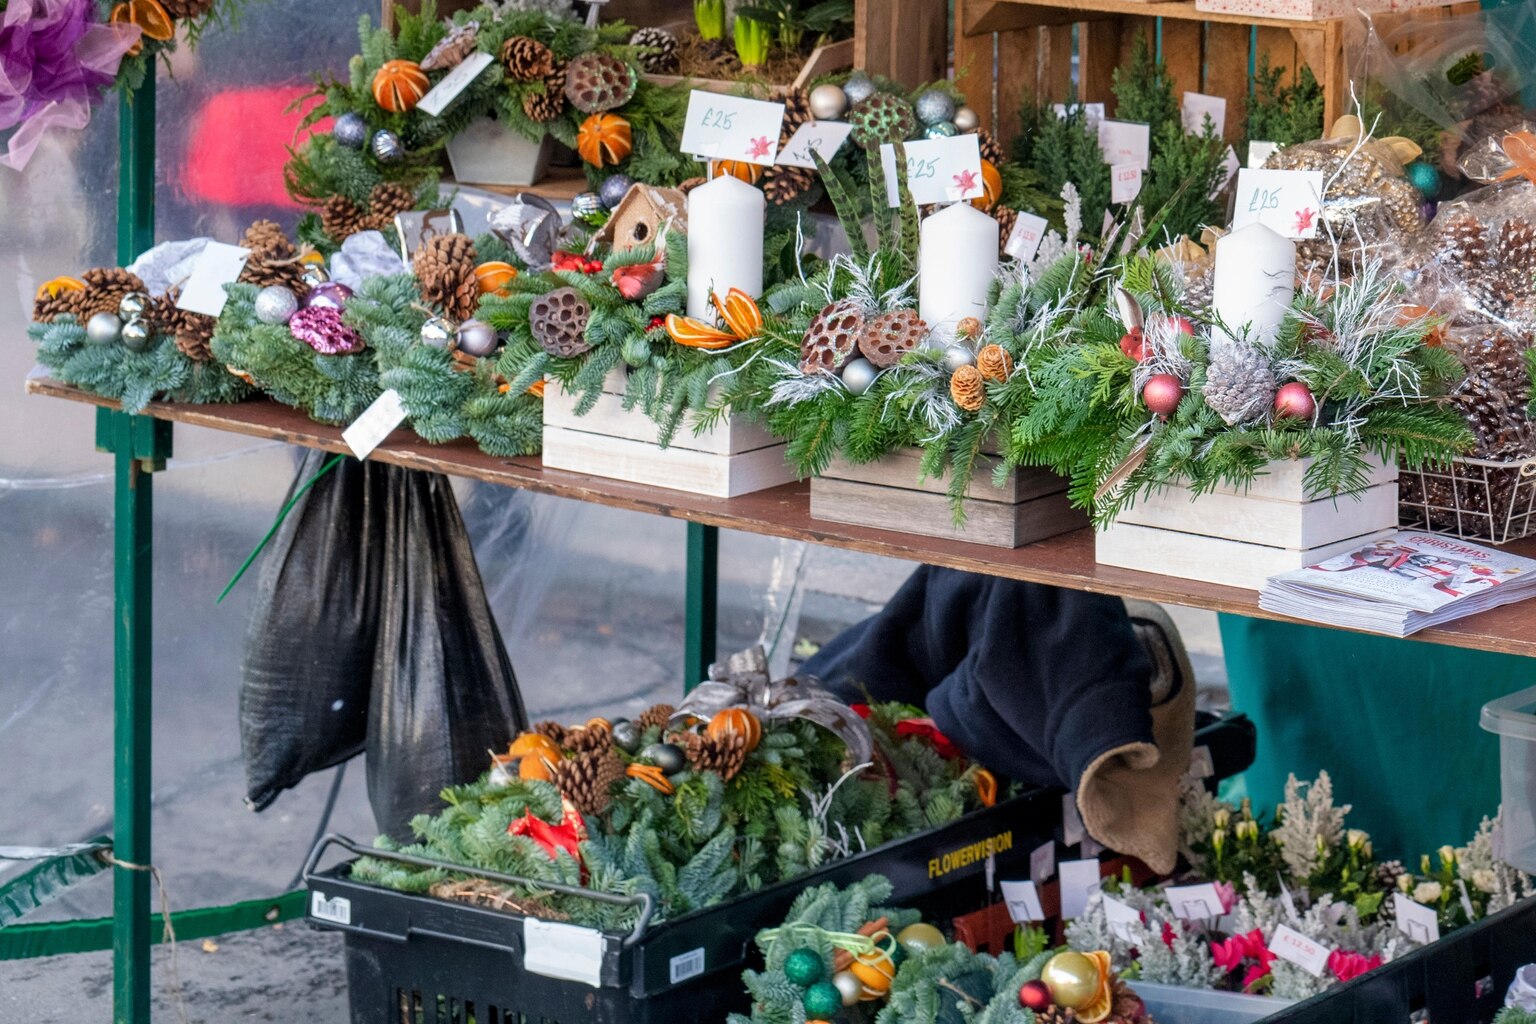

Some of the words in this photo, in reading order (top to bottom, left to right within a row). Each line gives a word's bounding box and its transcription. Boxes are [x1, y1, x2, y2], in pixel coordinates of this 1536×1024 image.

[701, 107, 737, 130] £25
[1408, 535, 1491, 559] CHRISTMAS
[928, 830, 1012, 879] FLOWERVISION
